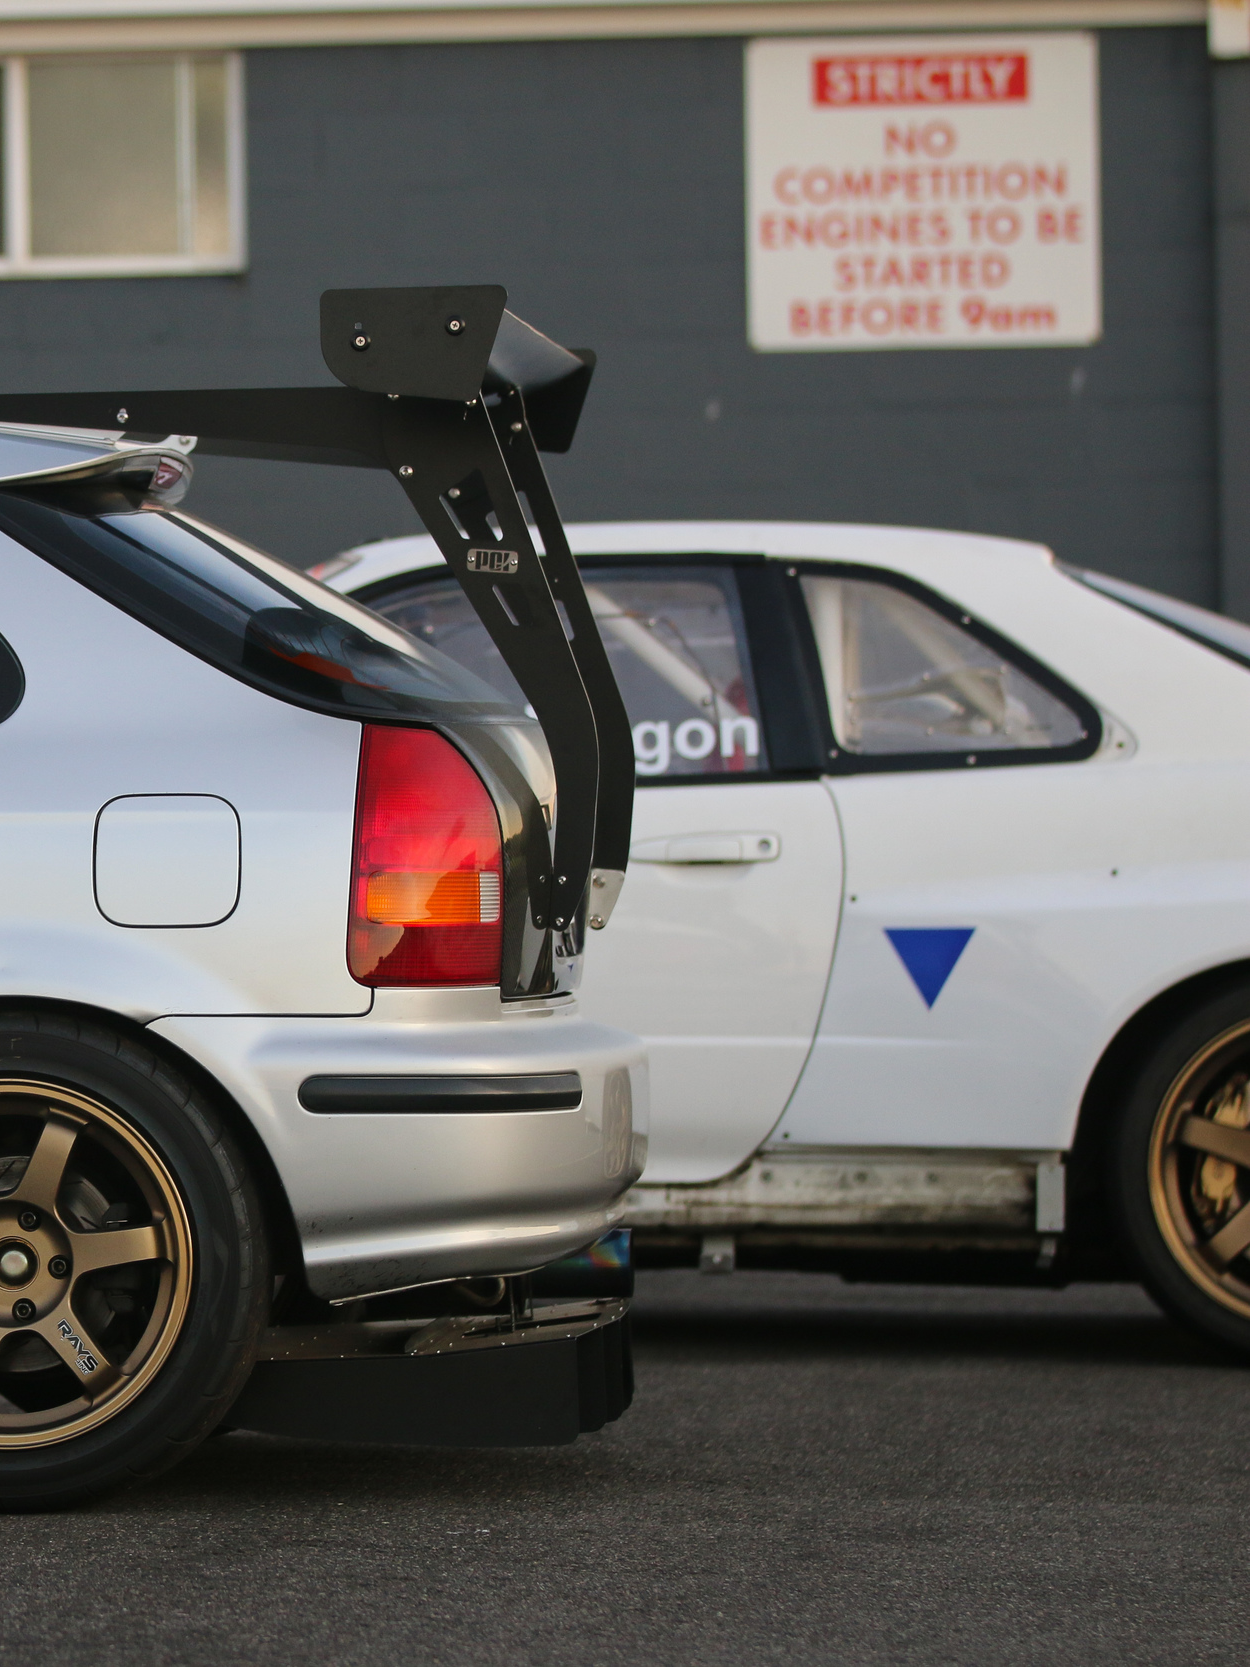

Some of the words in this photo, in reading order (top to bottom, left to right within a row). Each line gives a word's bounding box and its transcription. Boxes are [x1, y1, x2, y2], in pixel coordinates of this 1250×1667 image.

[825, 59, 1017, 101] STRICTLY
[884, 120, 957, 158] NO
[772, 161, 1067, 206] COMPETITION
[759, 210, 951, 250] ENGINES
[967, 204, 1022, 246] TO
[1036, 205, 1083, 244] BE
[835, 251, 1011, 292] STARTED
[789, 297, 944, 337] BEFORE
[960, 296, 1057, 332] 9am
[632, 714, 759, 776] gon
[57, 1318, 99, 1373] RAYS
